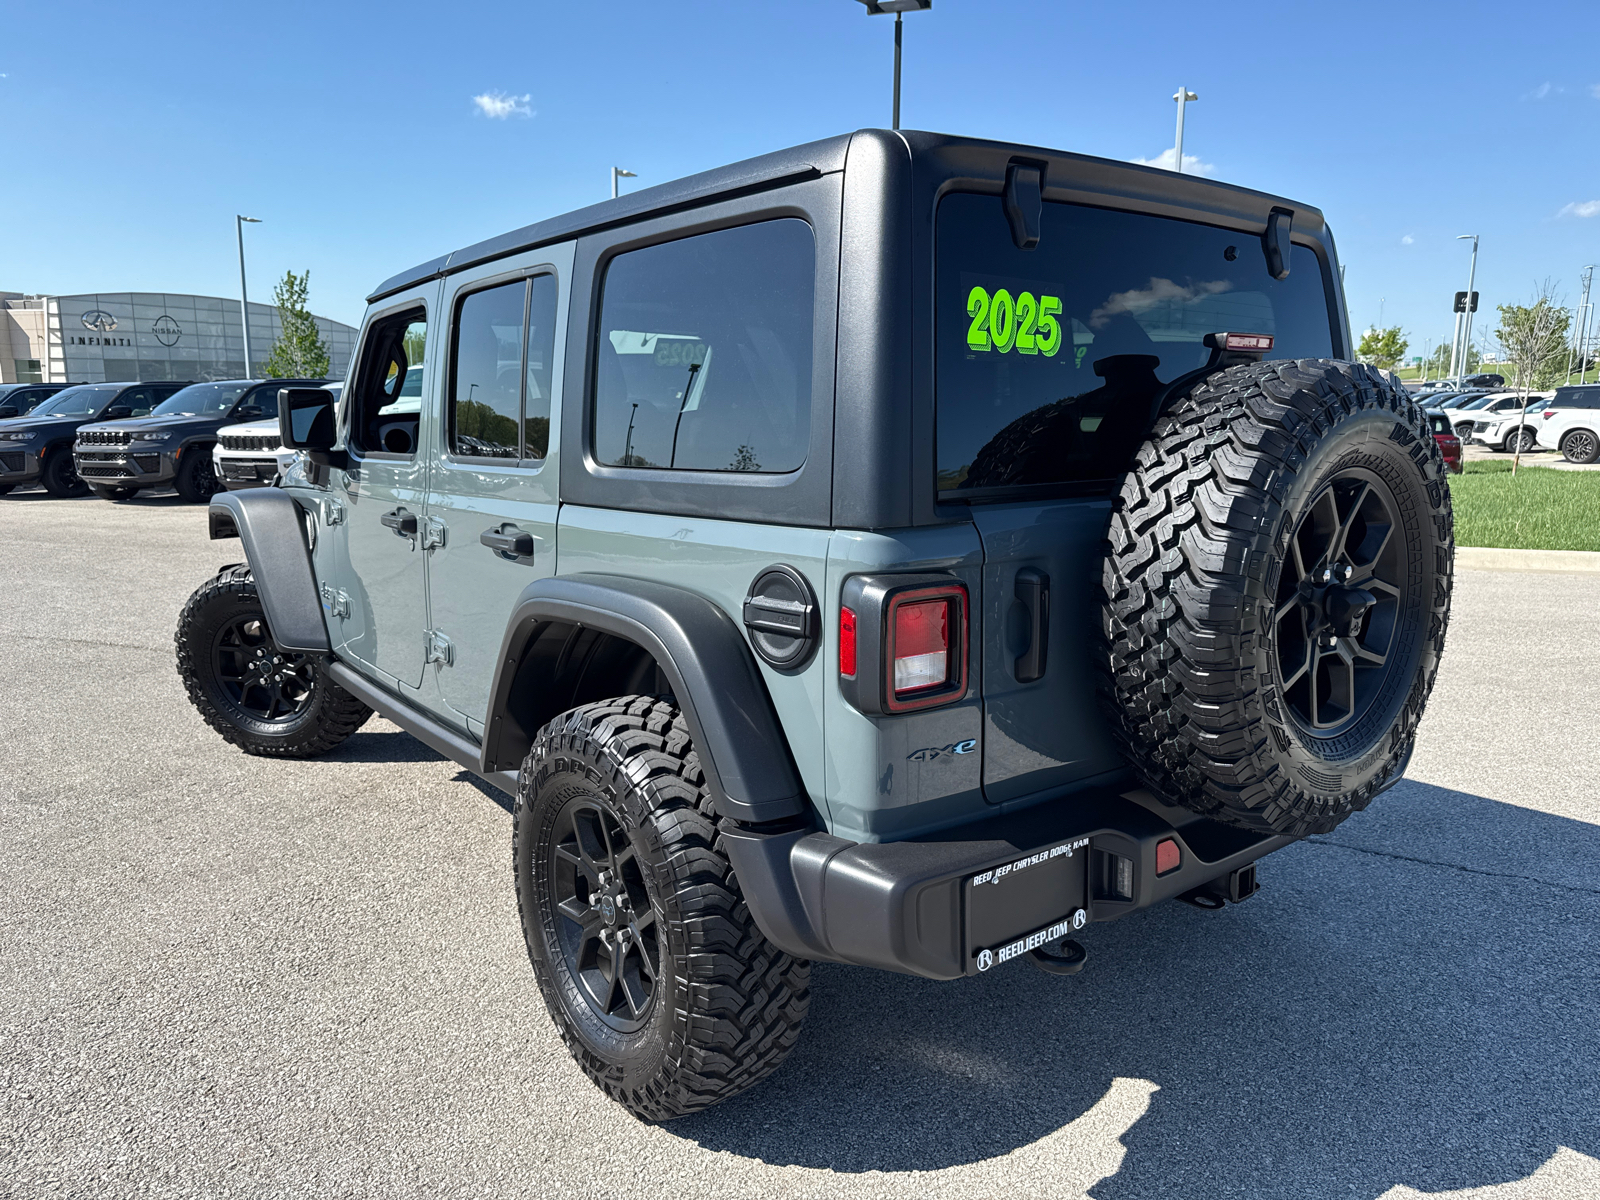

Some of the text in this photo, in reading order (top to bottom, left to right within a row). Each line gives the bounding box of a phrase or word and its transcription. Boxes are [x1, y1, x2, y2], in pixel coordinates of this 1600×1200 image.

[70, 336, 131, 347] INFINITI
[151, 327, 183, 335] NISSAN
[966, 286, 1062, 357] 2025
[973, 837, 1089, 886] REED JEEP CHRYSLER DODGE RAM
[998, 921, 1068, 963] REEDJEEP.COM
